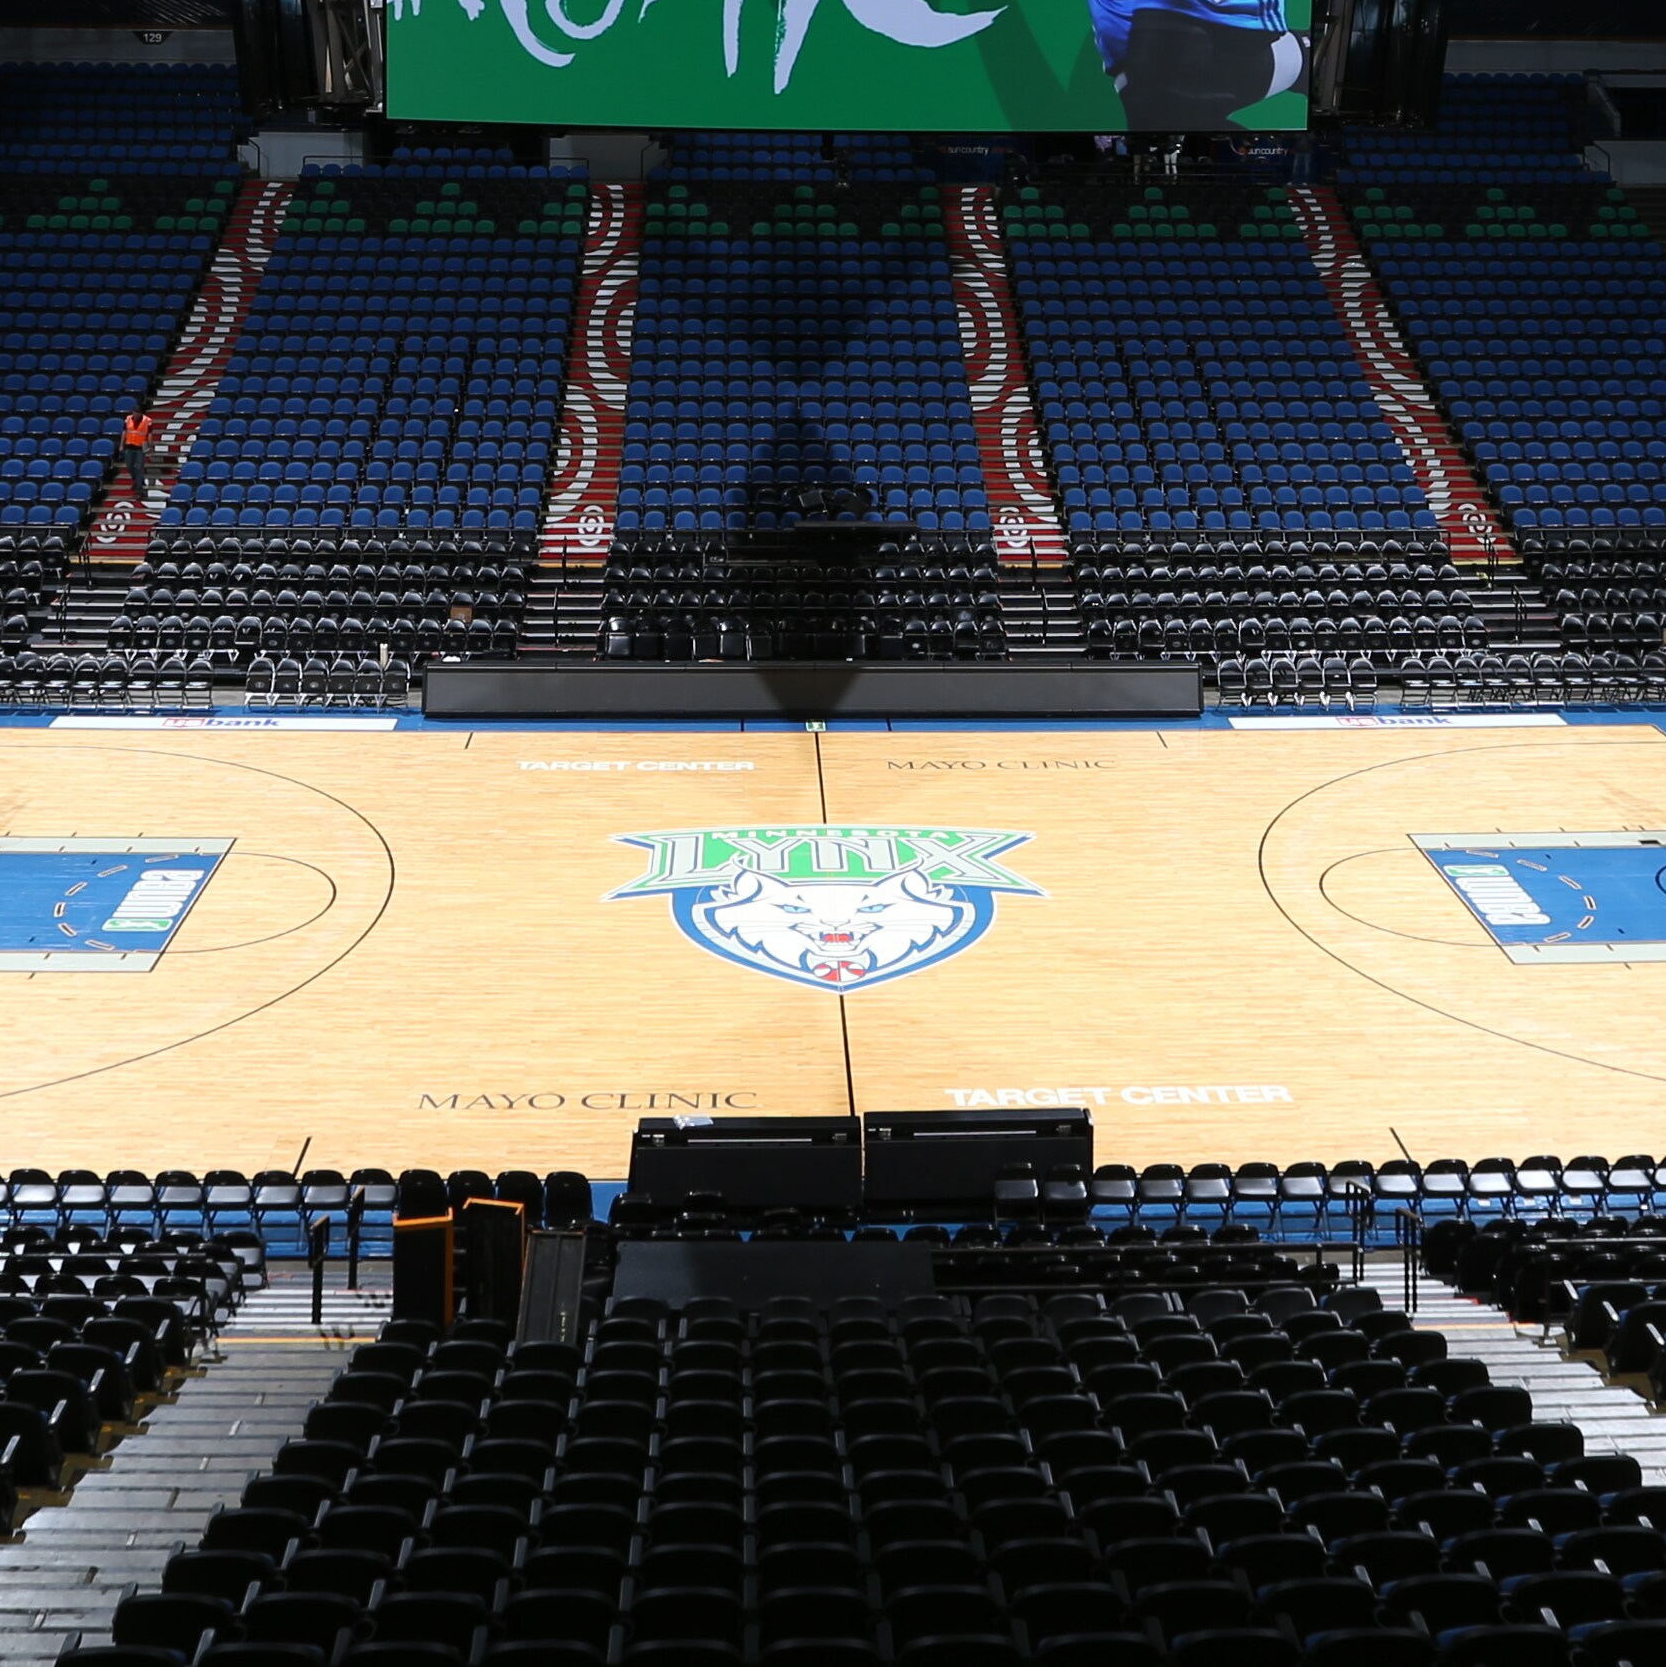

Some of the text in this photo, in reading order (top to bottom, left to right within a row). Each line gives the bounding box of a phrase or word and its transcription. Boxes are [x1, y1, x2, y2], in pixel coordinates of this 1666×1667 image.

[143, 33, 163, 44] 129
[516, 760, 755, 772] TARGET CENTER
[887, 760, 1116, 770] MAYO CLINIC
[711, 828, 950, 839] MINNESOTA
[657, 833, 1017, 882] LYNX
[416, 1091, 758, 1110] MAYO CLINIC
[944, 1083, 1295, 1107] TARGET CENTER
